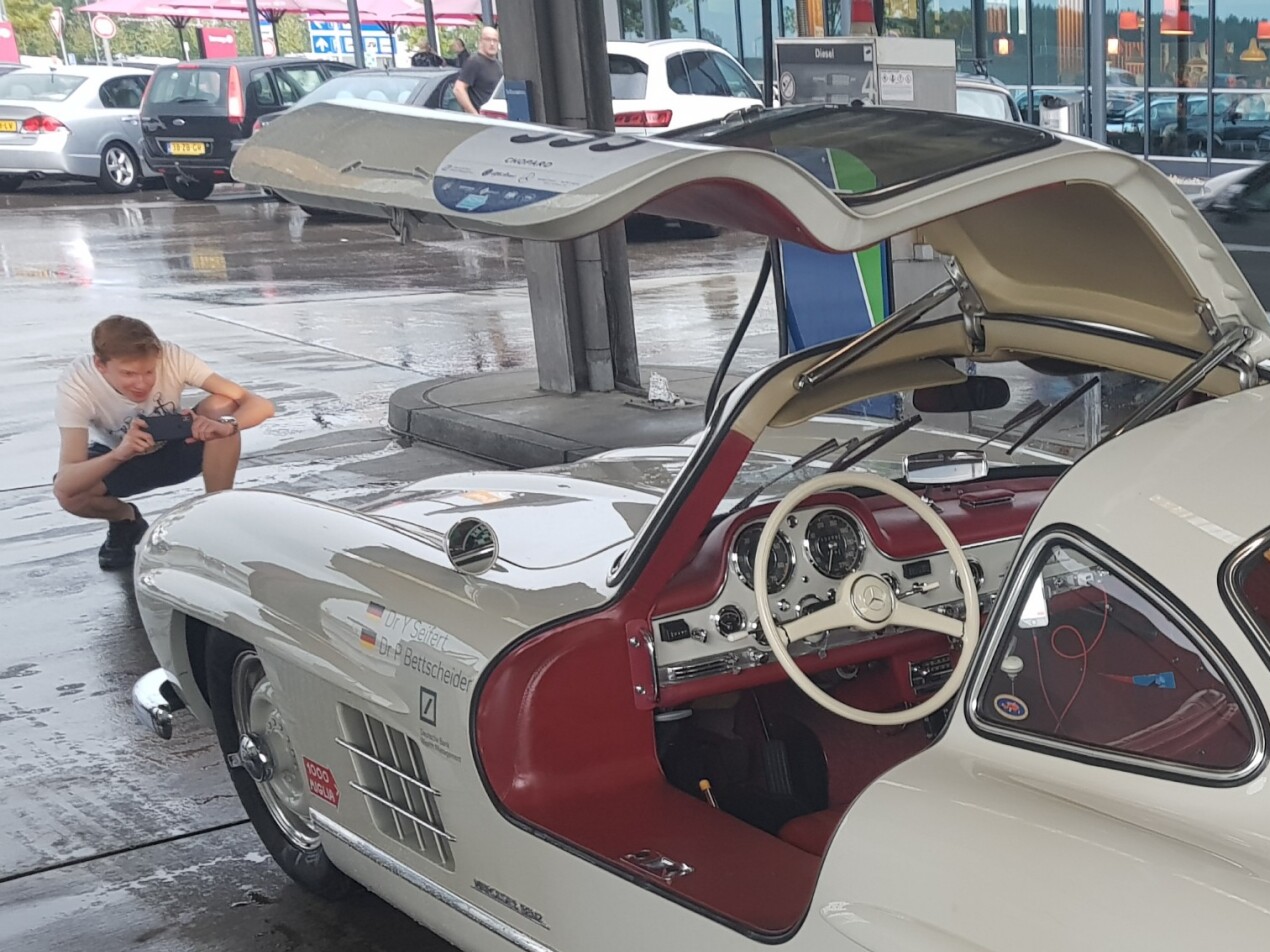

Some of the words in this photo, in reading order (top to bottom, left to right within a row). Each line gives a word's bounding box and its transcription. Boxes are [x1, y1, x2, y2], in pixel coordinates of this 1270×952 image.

[814, 47, 835, 59] Diesel
[384, 610, 400, 630] Dr
[401, 616, 411, 634] Y
[410, 619, 449, 652] Seifert
[379, 636, 392, 657] Dr
[394, 642, 403, 661] P
[403, 647, 473, 693] Bettscheider
[306, 761, 330, 784] 1000
[309, 778, 336, 803] MIGLIA
